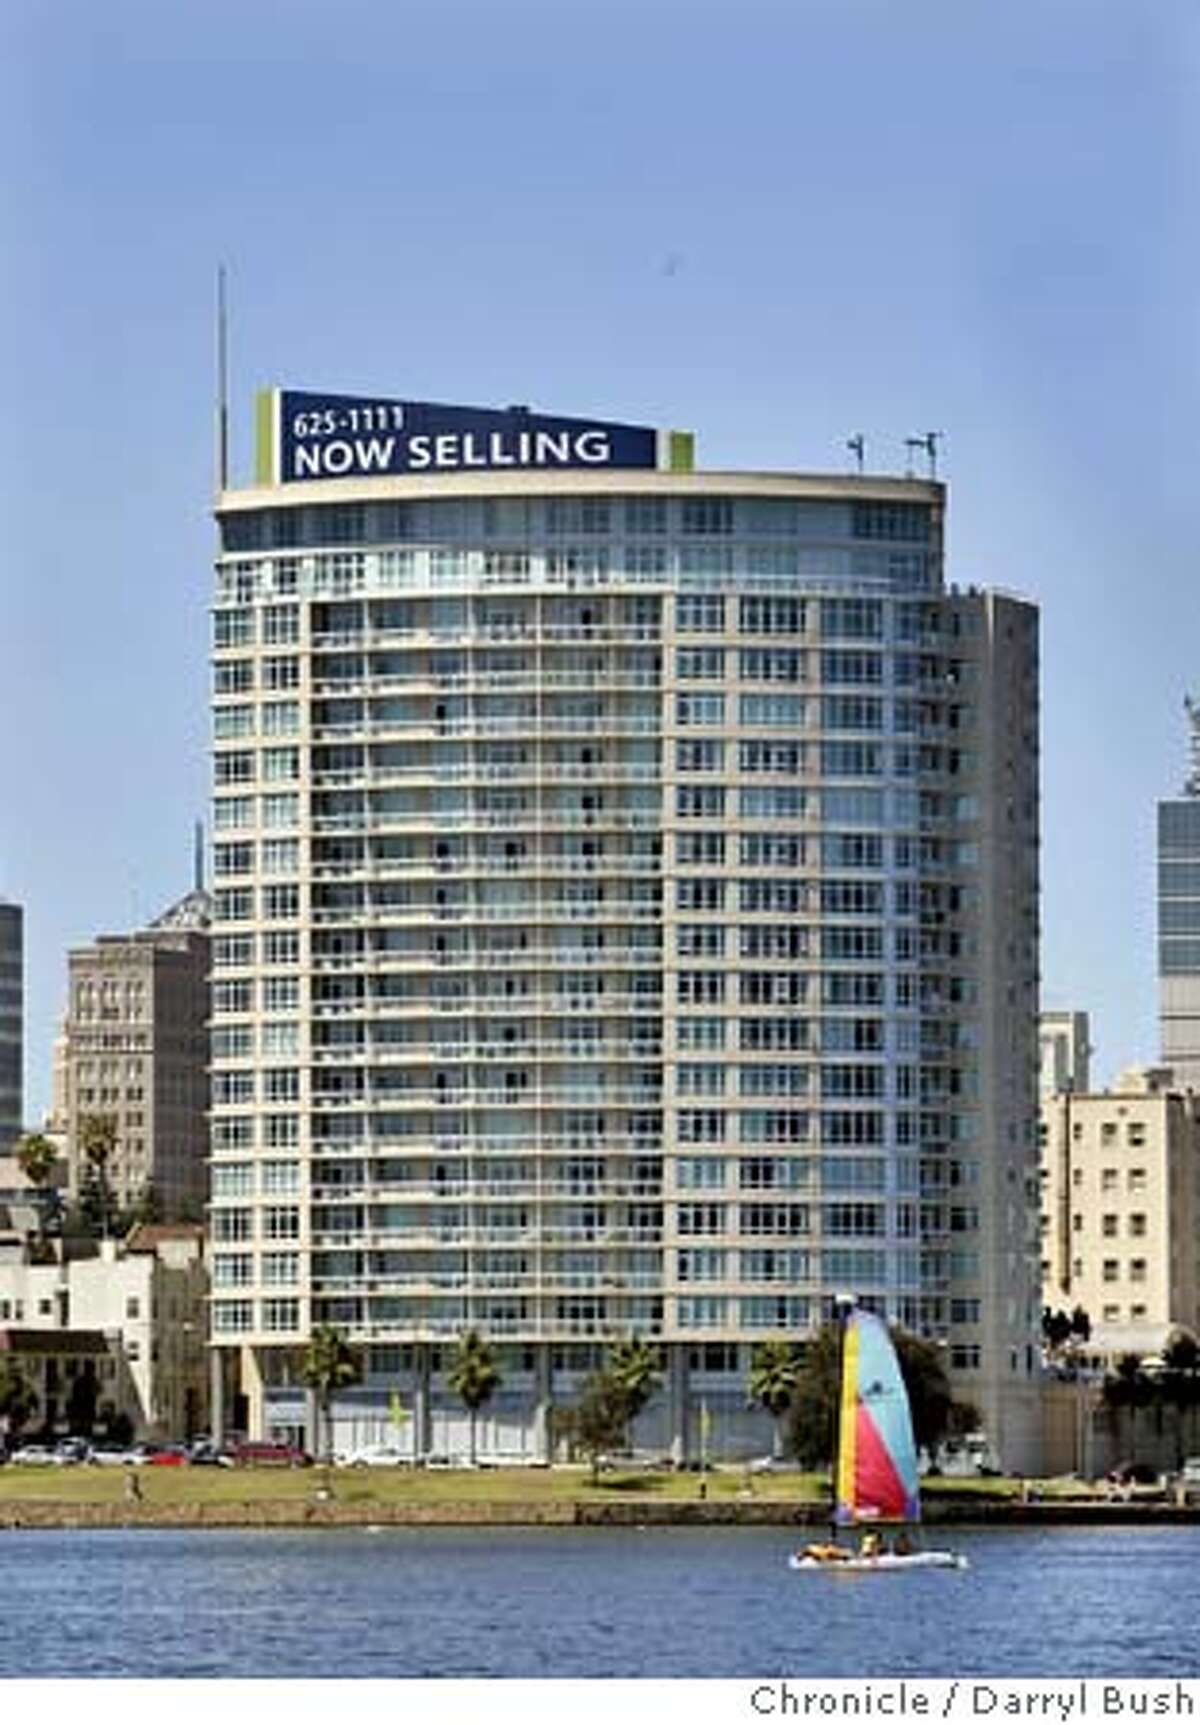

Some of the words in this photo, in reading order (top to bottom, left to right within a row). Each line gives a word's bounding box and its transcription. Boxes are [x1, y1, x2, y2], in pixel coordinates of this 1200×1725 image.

[293, 405, 405, 437] 625-1111
[294, 437, 396, 475] NOW
[408, 431, 611, 467] SELLING
